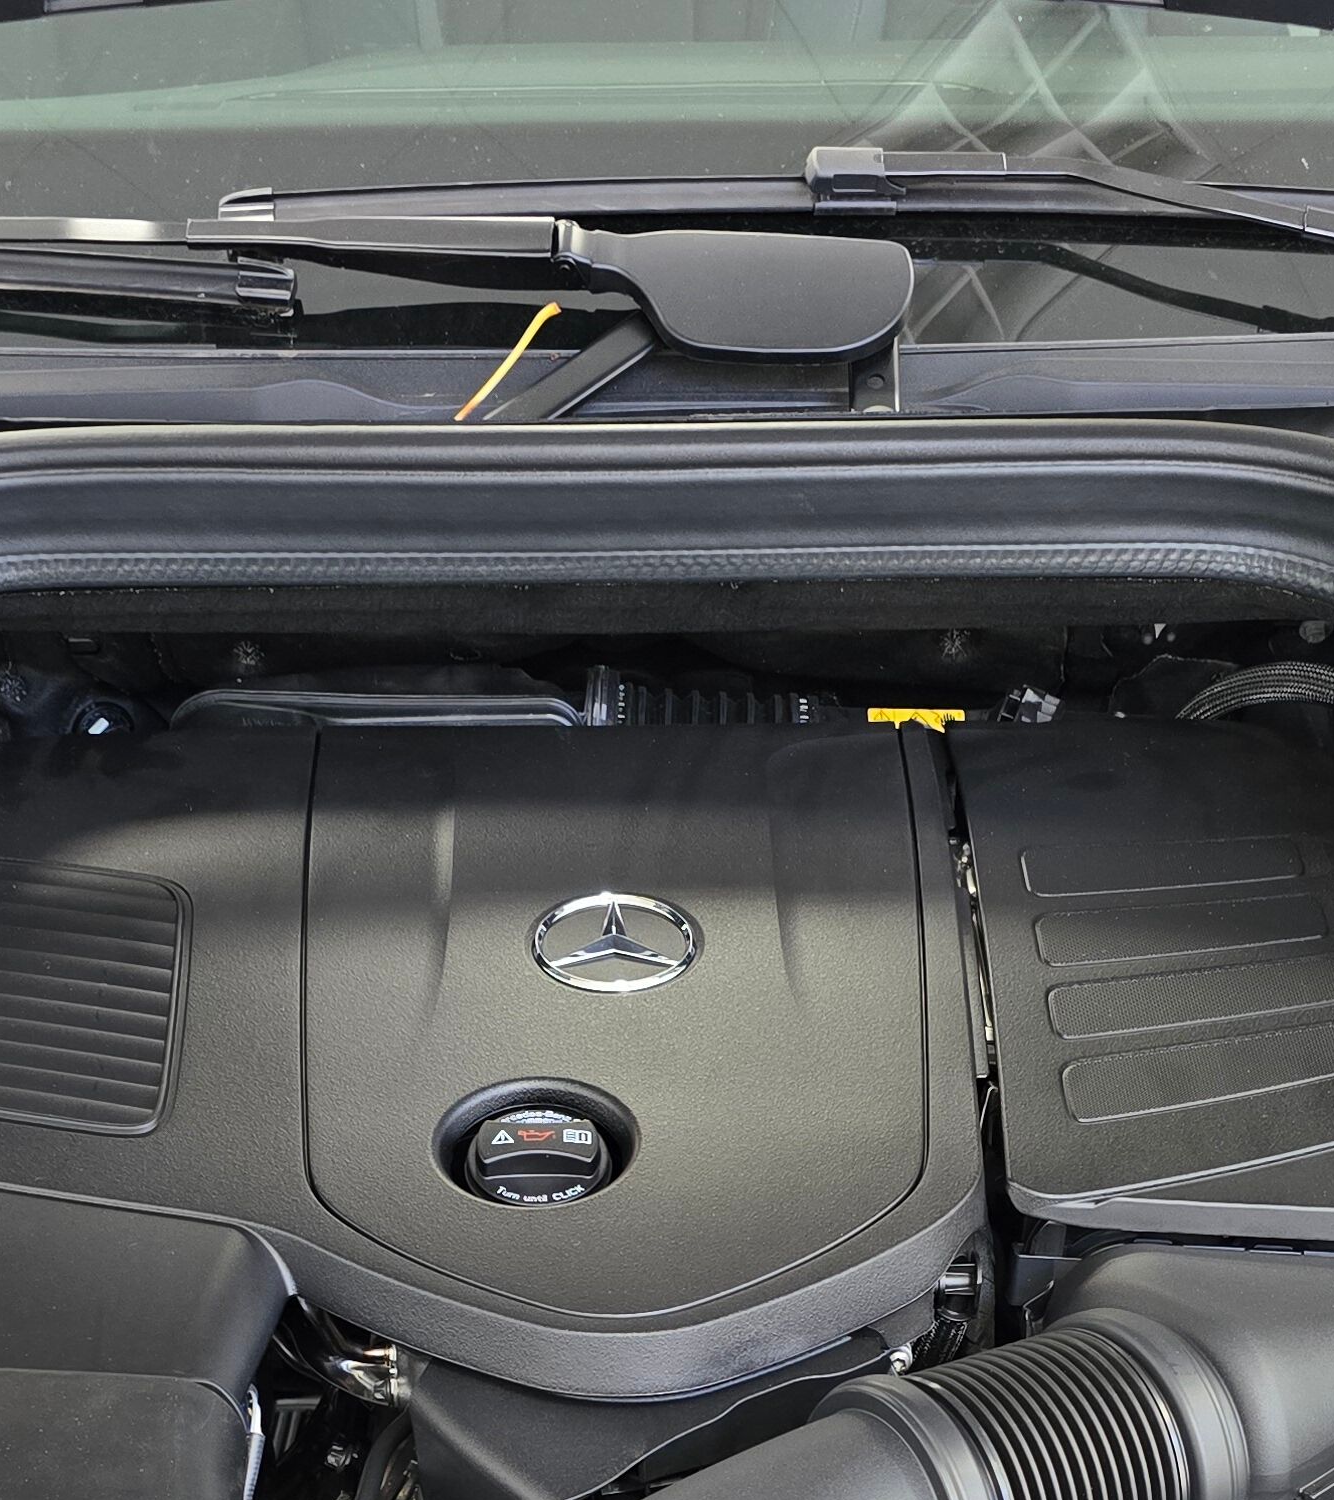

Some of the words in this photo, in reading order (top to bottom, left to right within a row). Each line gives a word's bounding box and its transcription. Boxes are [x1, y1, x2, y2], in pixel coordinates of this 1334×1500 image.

[496, 1185, 520, 1201] Turn
[522, 1193, 548, 1203] until
[552, 1184, 586, 1201] CLICK
